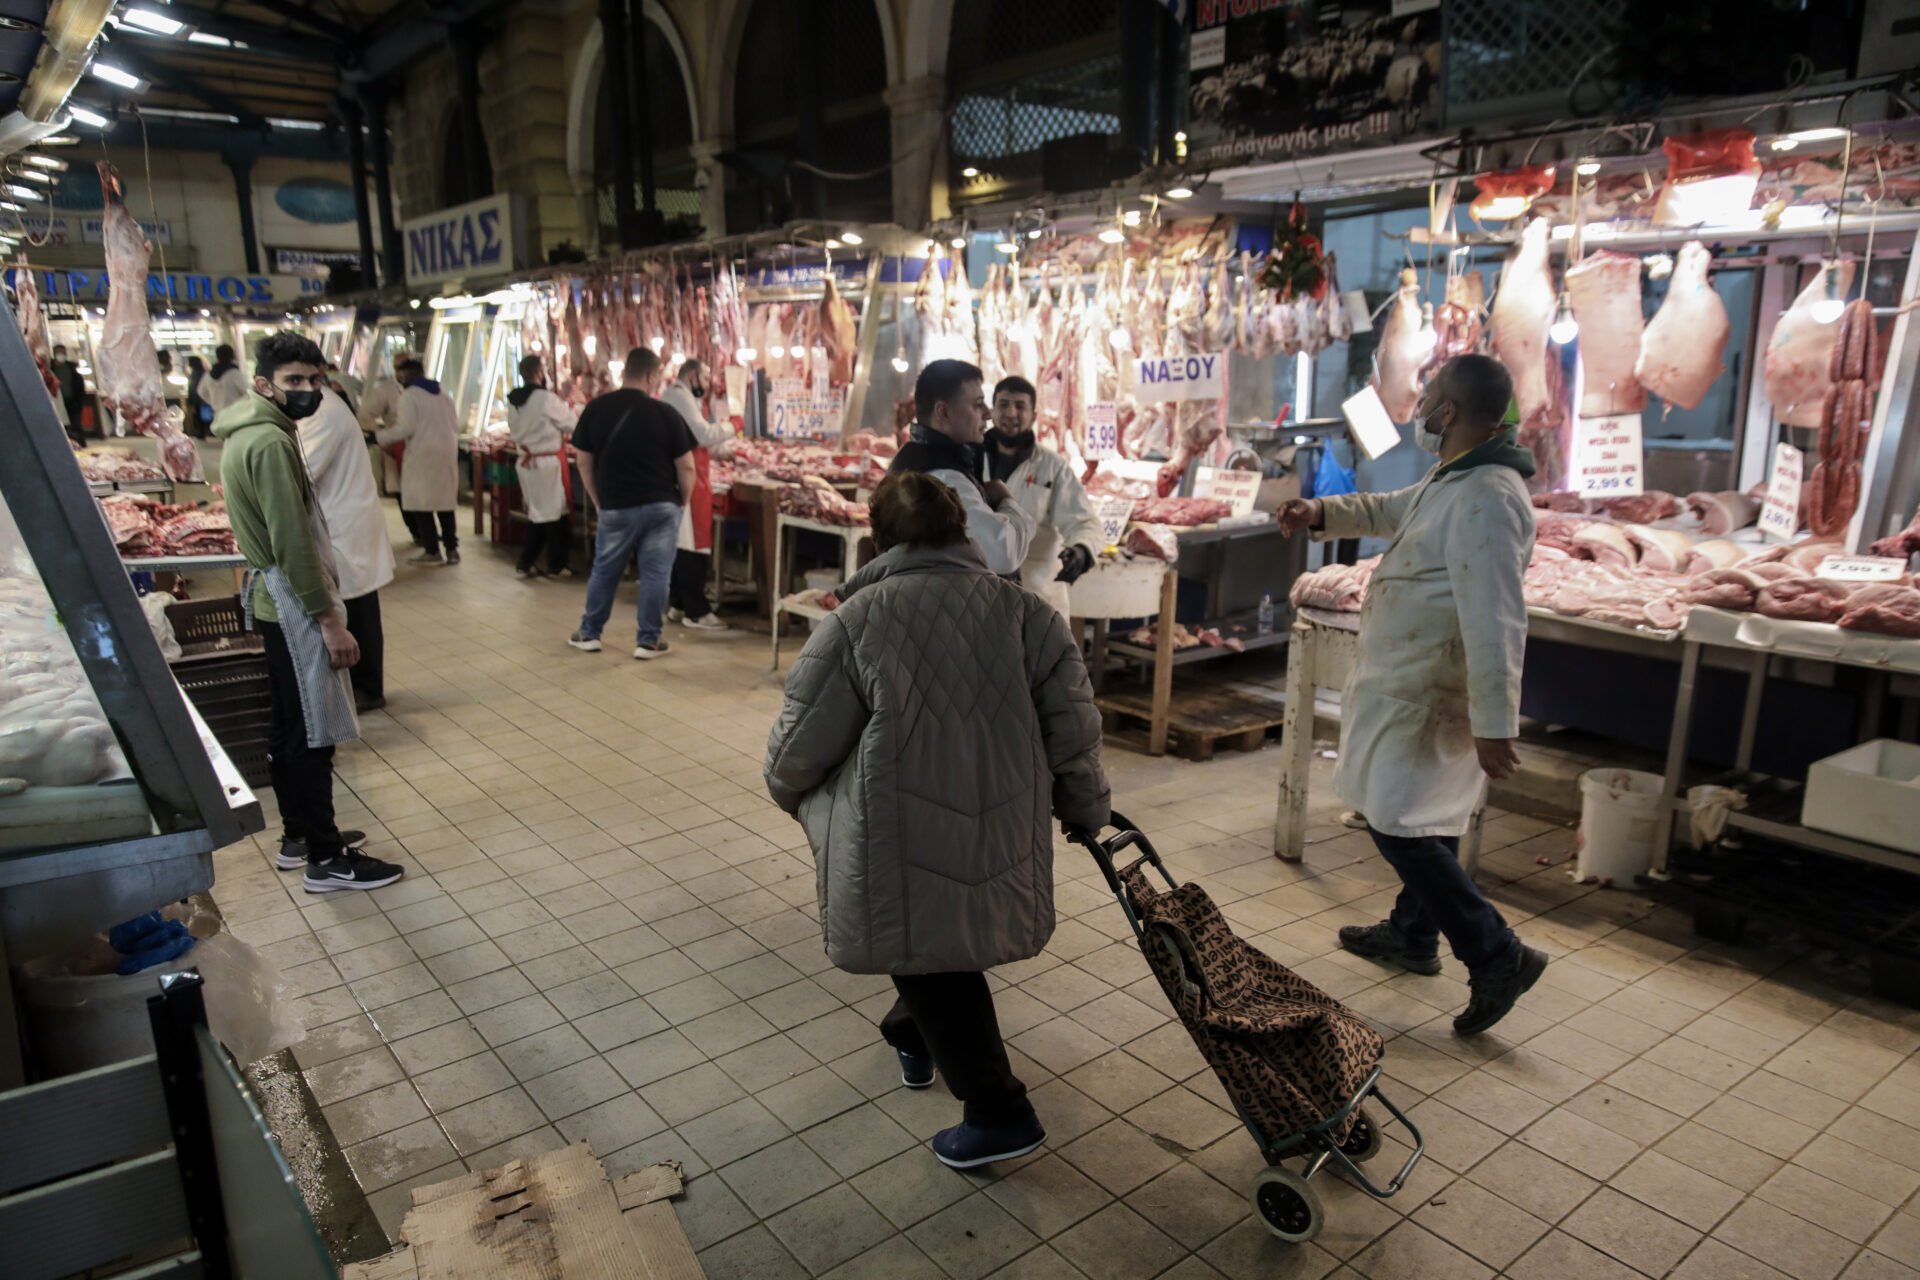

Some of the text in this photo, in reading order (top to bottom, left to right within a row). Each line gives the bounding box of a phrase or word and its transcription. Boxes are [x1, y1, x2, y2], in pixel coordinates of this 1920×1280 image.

[1324, 120, 1363, 147] μας
[408, 207, 502, 278] ΝΙΚΑΣ
[1140, 355, 1216, 385] ΝΑΞΟΥ
[1088, 425, 1116, 454] 5,99
[1587, 477, 1620, 491] 2,99
